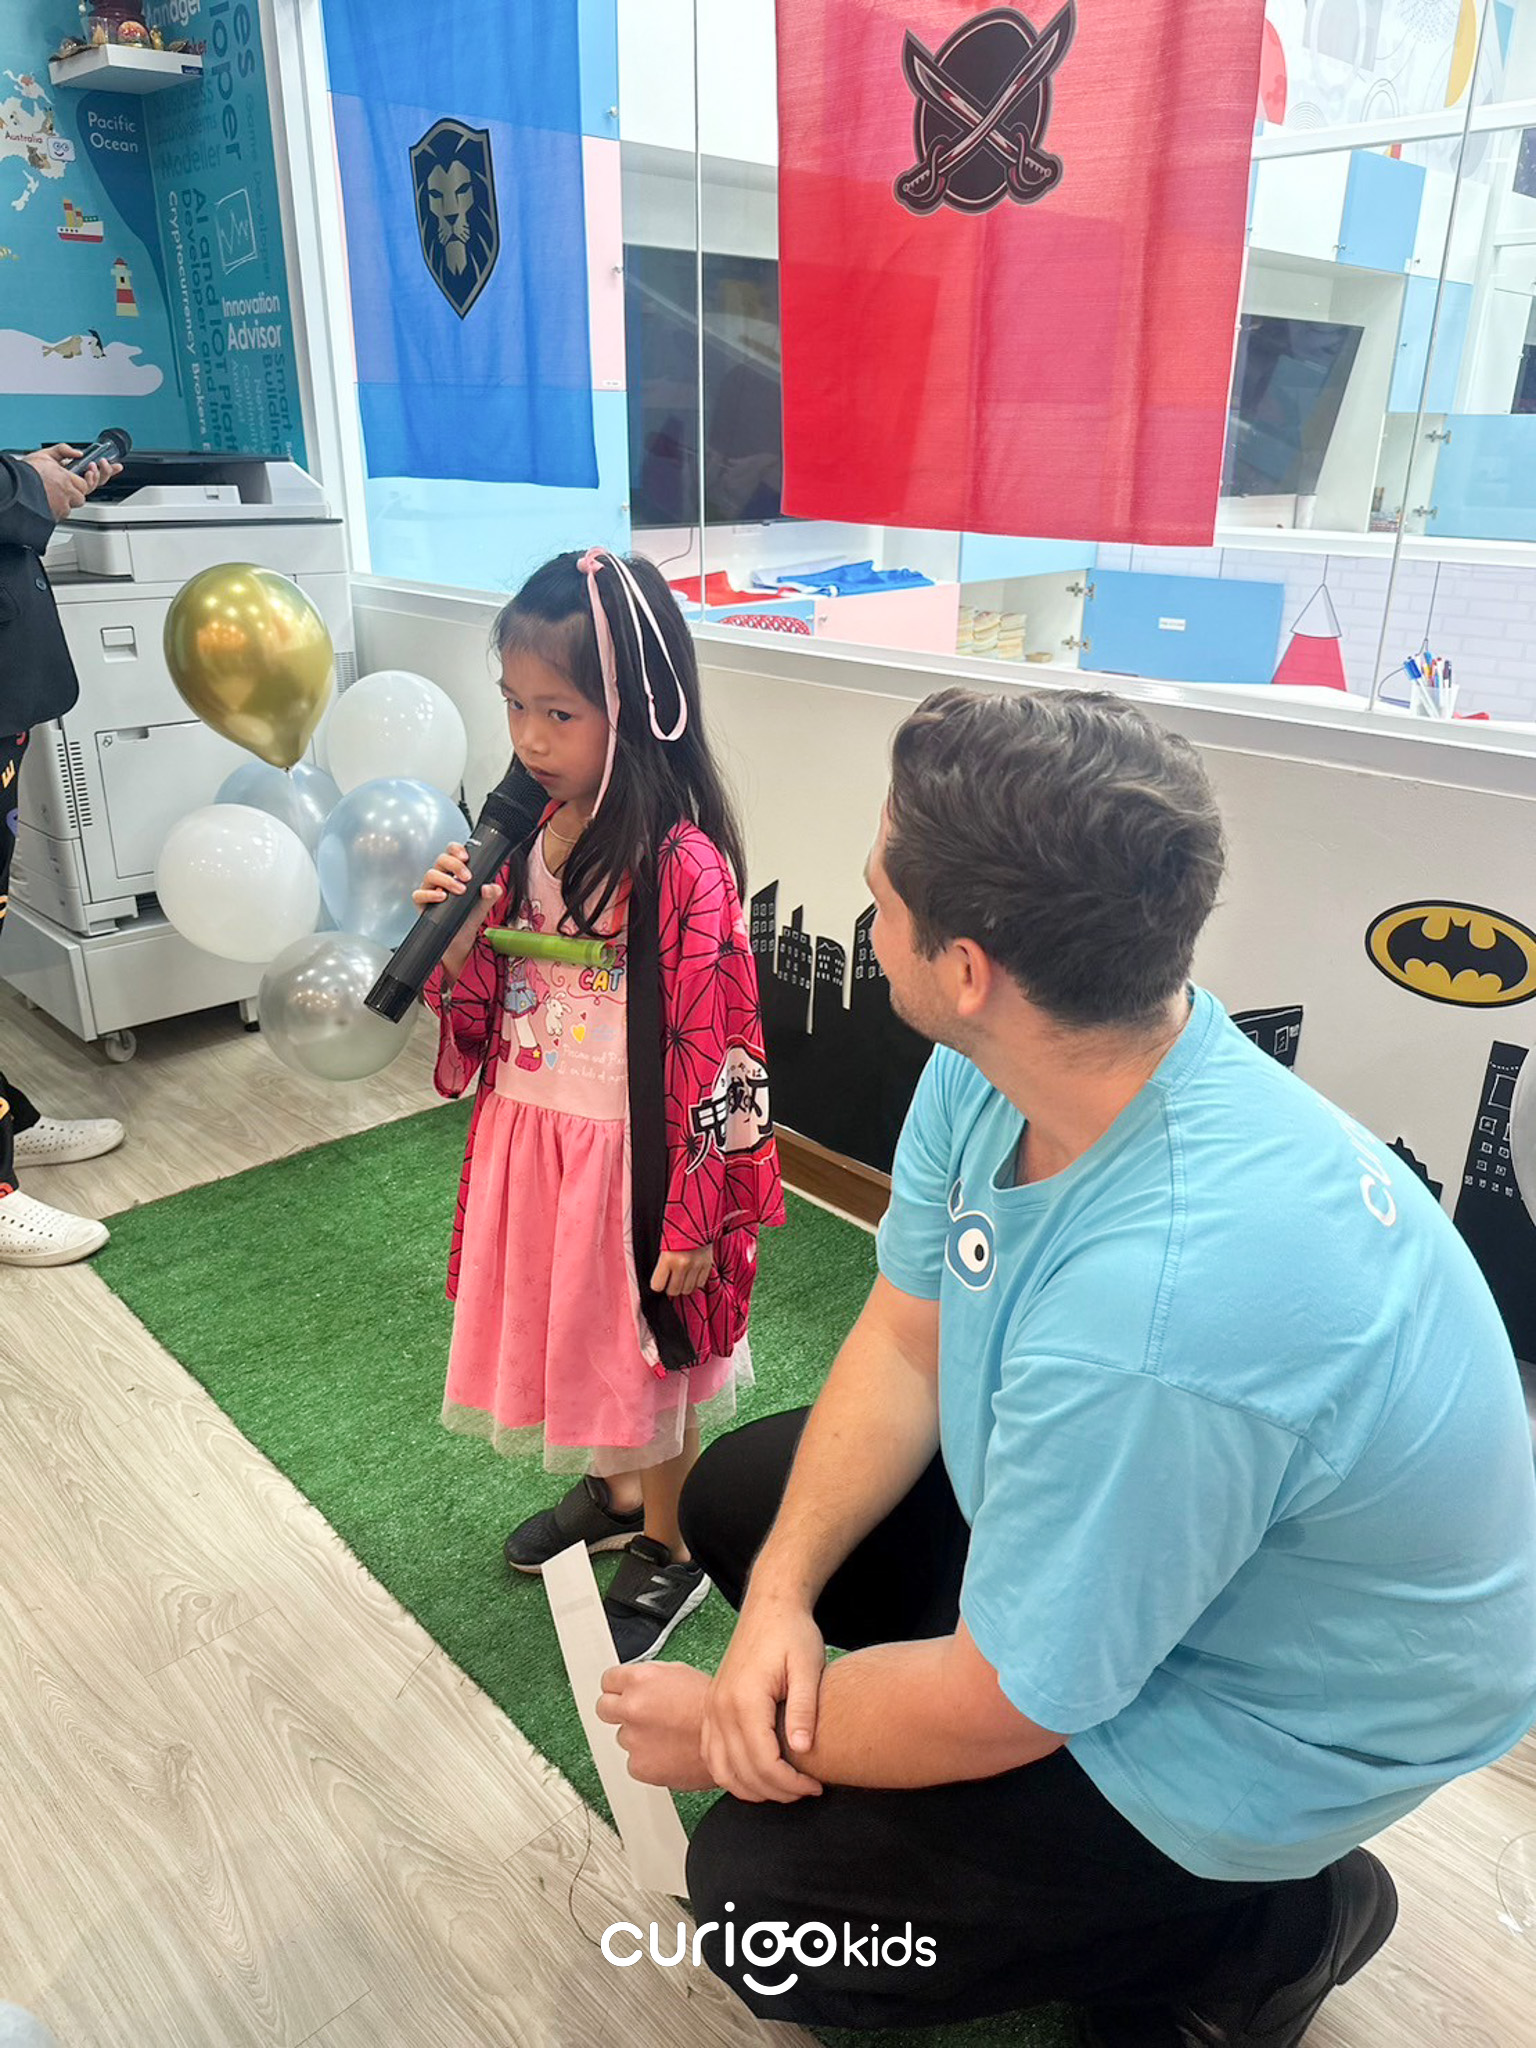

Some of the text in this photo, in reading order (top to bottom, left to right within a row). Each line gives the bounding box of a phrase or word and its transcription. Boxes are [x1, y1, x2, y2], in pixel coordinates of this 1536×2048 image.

[5, 131, 43, 143] Australia
[87, 111, 137, 132] Pacific
[90, 132, 139, 153] Ocean
[192, 187, 209, 224] AI
[200, 236, 220, 306] and
[182, 189, 206, 333] Developer
[202, 341, 216, 392] and
[222, 290, 280, 317] Innovation
[168, 190, 196, 355] Cryptocurrency
[192, 363, 207, 435] Brokers
[227, 320, 282, 351] Advisor
[275, 353, 293, 431] Smart
[579, 967, 625, 992] CAT
